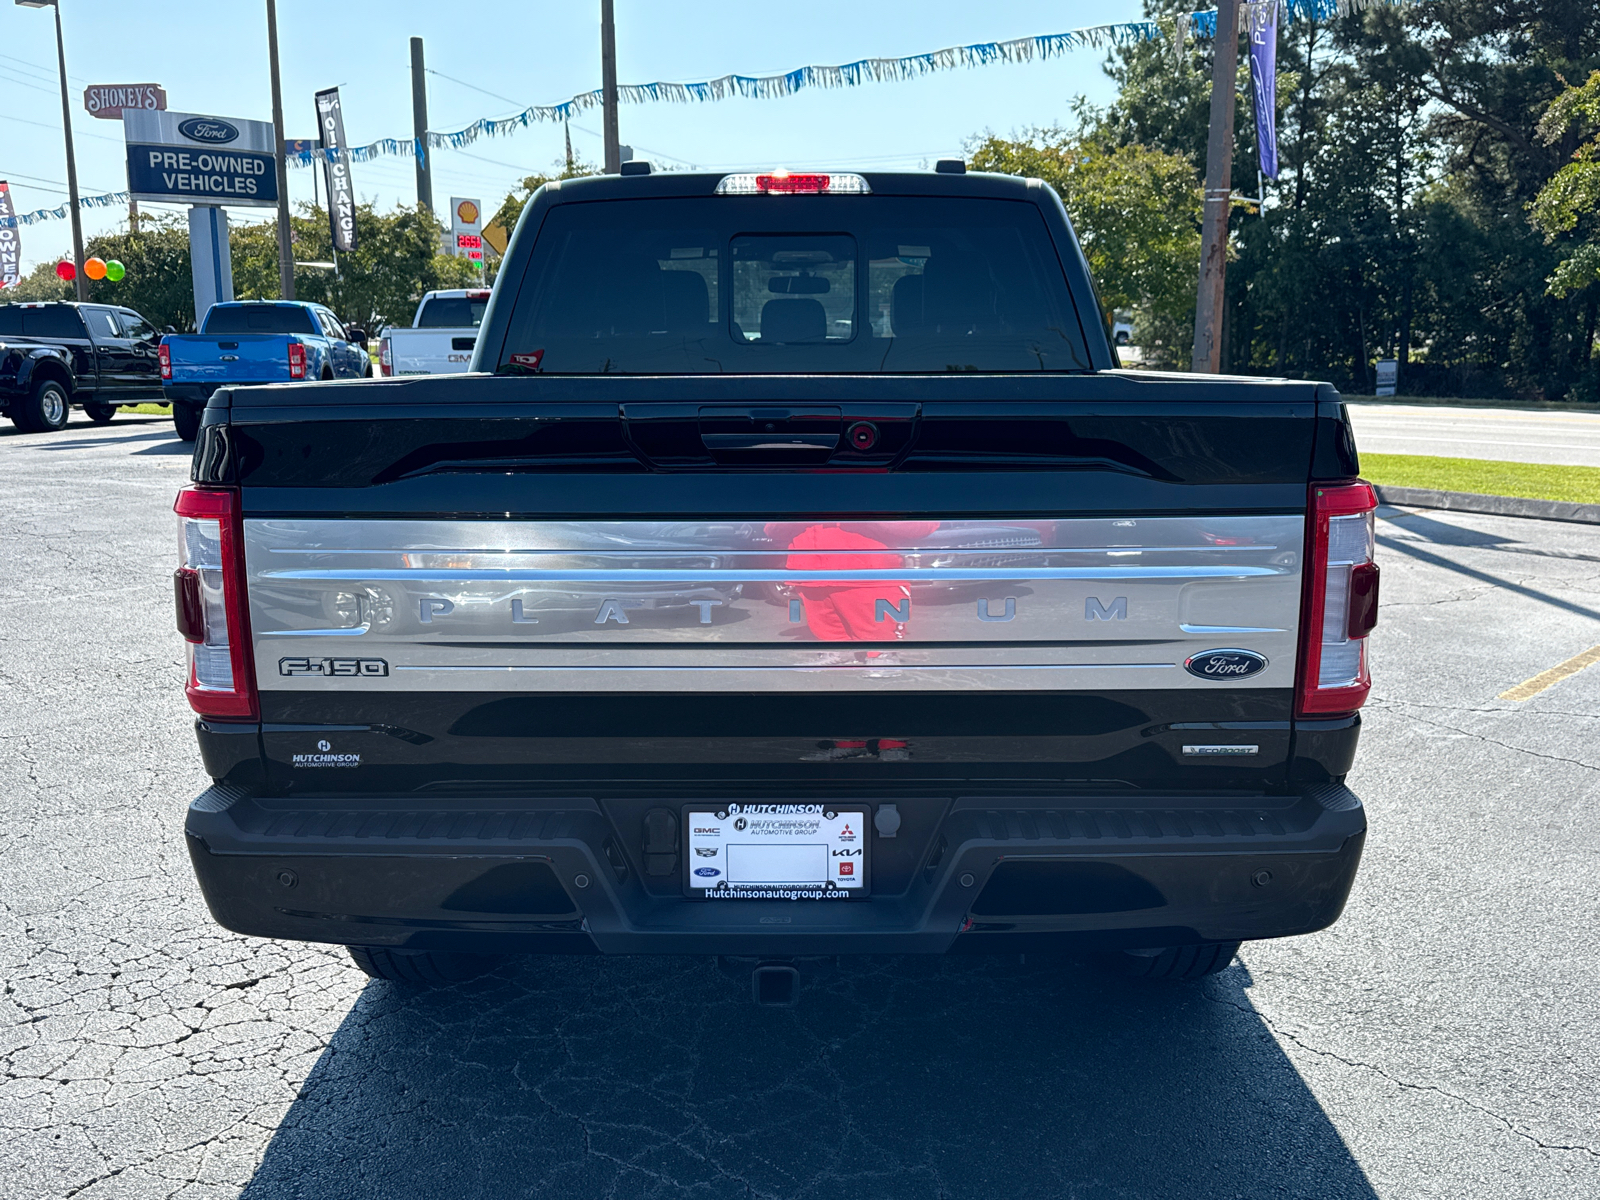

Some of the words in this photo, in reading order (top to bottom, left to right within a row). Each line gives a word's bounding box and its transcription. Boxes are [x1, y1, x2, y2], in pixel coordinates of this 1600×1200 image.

[88, 86, 158, 112] SHONEY'S
[194, 123, 227, 139] Ford
[150, 151, 265, 176] PRE-OWNED
[162, 172, 258, 195] VEHICLES
[332, 163, 353, 244] CHANGE
[448, 354, 472, 363] GM
[419, 596, 1128, 624] PLATINUM
[280, 657, 389, 676] F-150
[1204, 655, 1250, 674] Ford
[292, 754, 360, 762] HUTCHINSON
[742, 804, 824, 814] HUTCHINSON
[750, 820, 820, 829] HUTCHINSON
[699, 868, 716, 876] Ford
[705, 888, 849, 901] Hutchinsonautogroup.com
